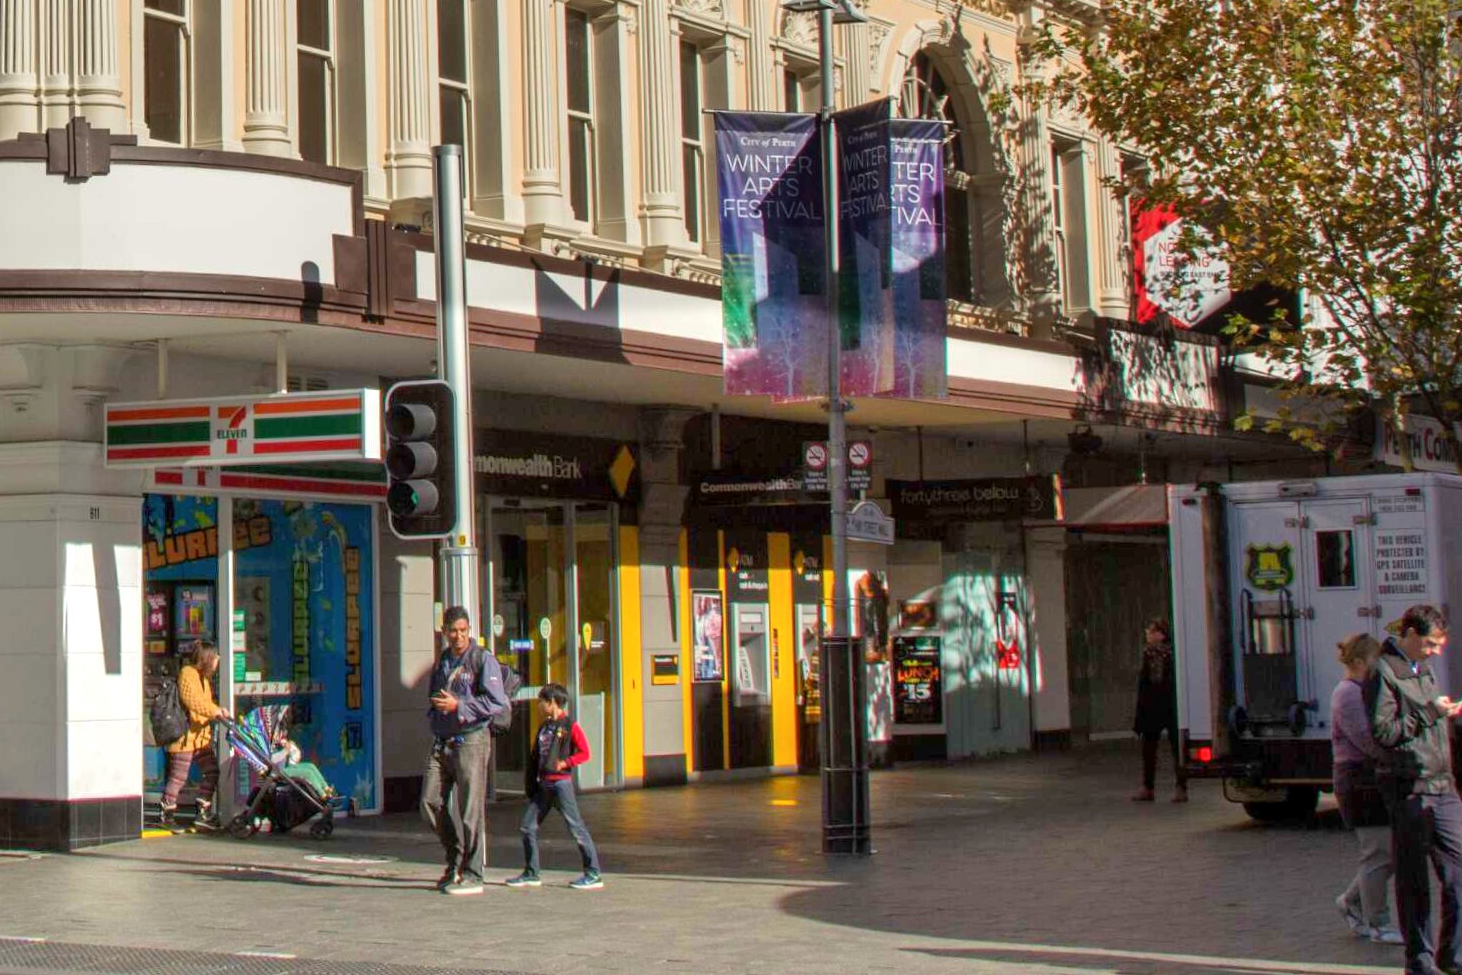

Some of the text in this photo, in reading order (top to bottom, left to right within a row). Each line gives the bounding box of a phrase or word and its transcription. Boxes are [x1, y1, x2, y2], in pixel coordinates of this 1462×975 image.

[761, 138, 770, 148] of
[726, 154, 813, 176] WINTER
[844, 145, 887, 171] WINTER
[892, 161, 934, 181] TER
[742, 177, 800, 197] ARTS
[849, 171, 879, 193] ARTS
[723, 198, 823, 220] FESTIVAL
[841, 193, 887, 220] FESTIVA
[891, 206, 944, 225] IVAL
[1159, 256, 1211, 268] LEING
[474, 453, 553, 477] monwealth
[973, 482, 1020, 501] below
[1378, 535, 1422, 545] THIS VEHICLE
[1377, 547, 1413, 557] PROTECTED
